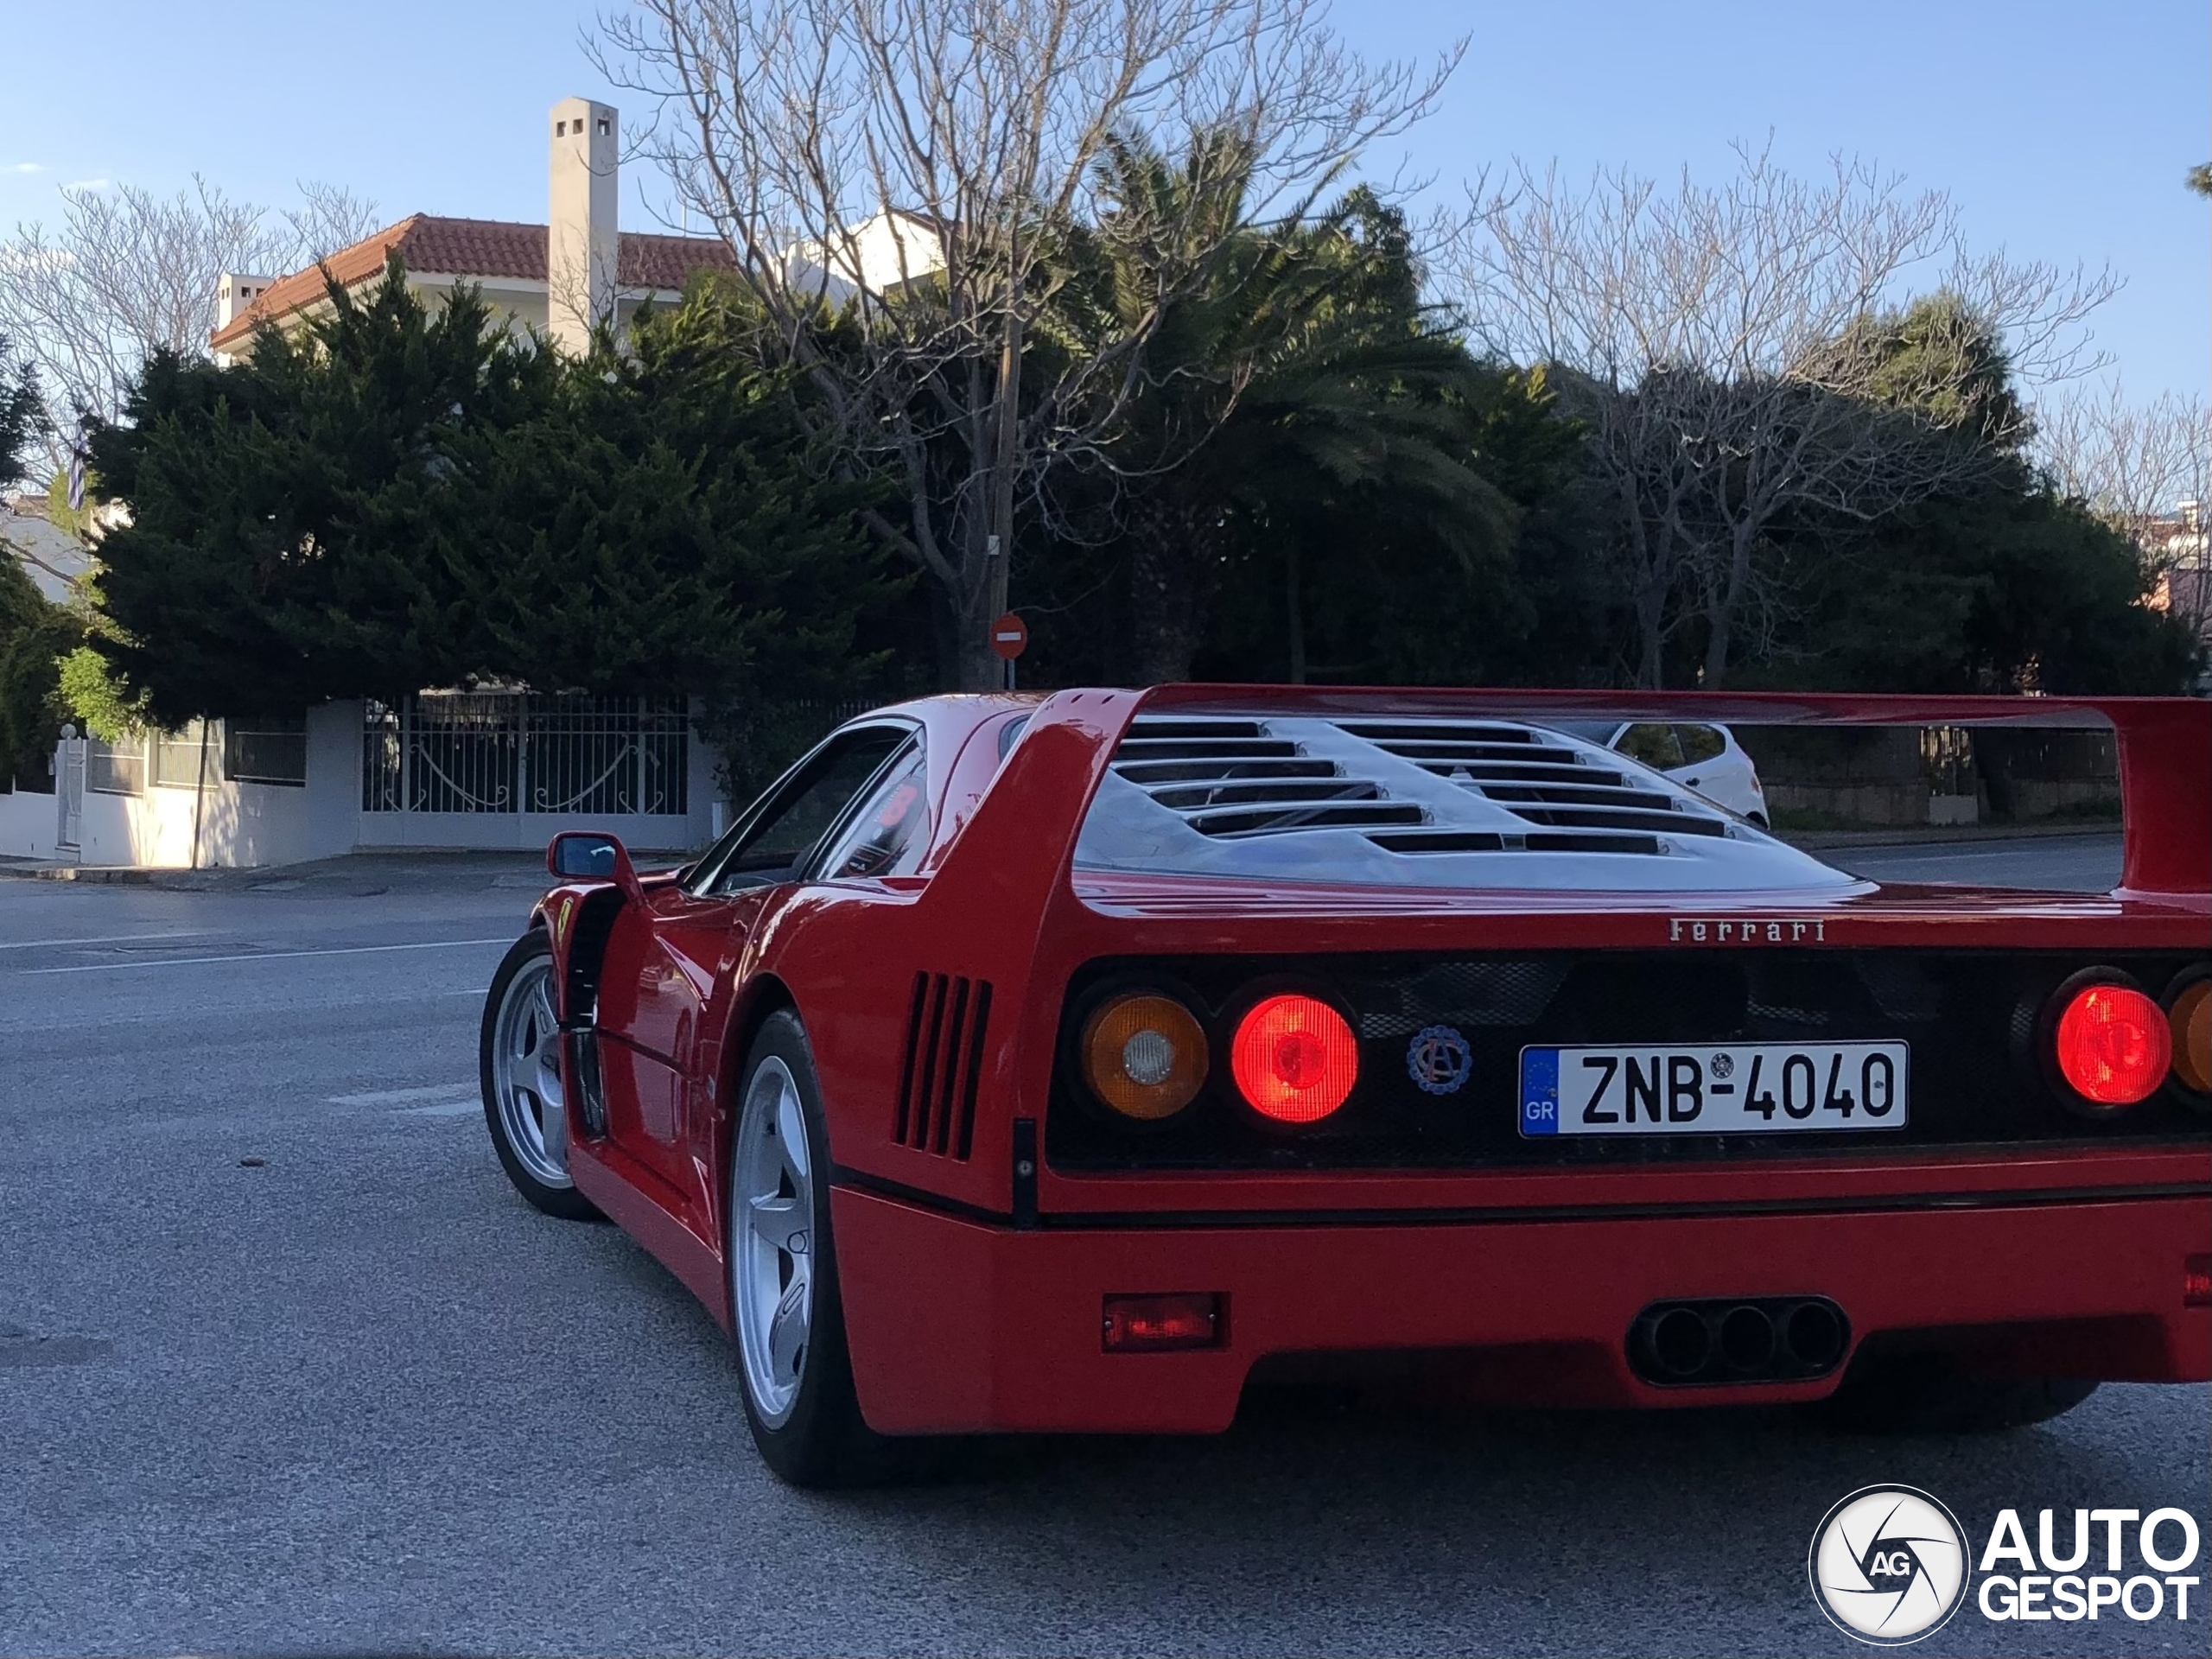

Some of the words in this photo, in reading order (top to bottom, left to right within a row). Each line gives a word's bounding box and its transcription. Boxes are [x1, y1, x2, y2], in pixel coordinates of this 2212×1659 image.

[1670, 918, 1824, 942] Ferrari
[1582, 1052, 1894, 1123] ZNB-4040
[1526, 1101, 1554, 1121] GR
